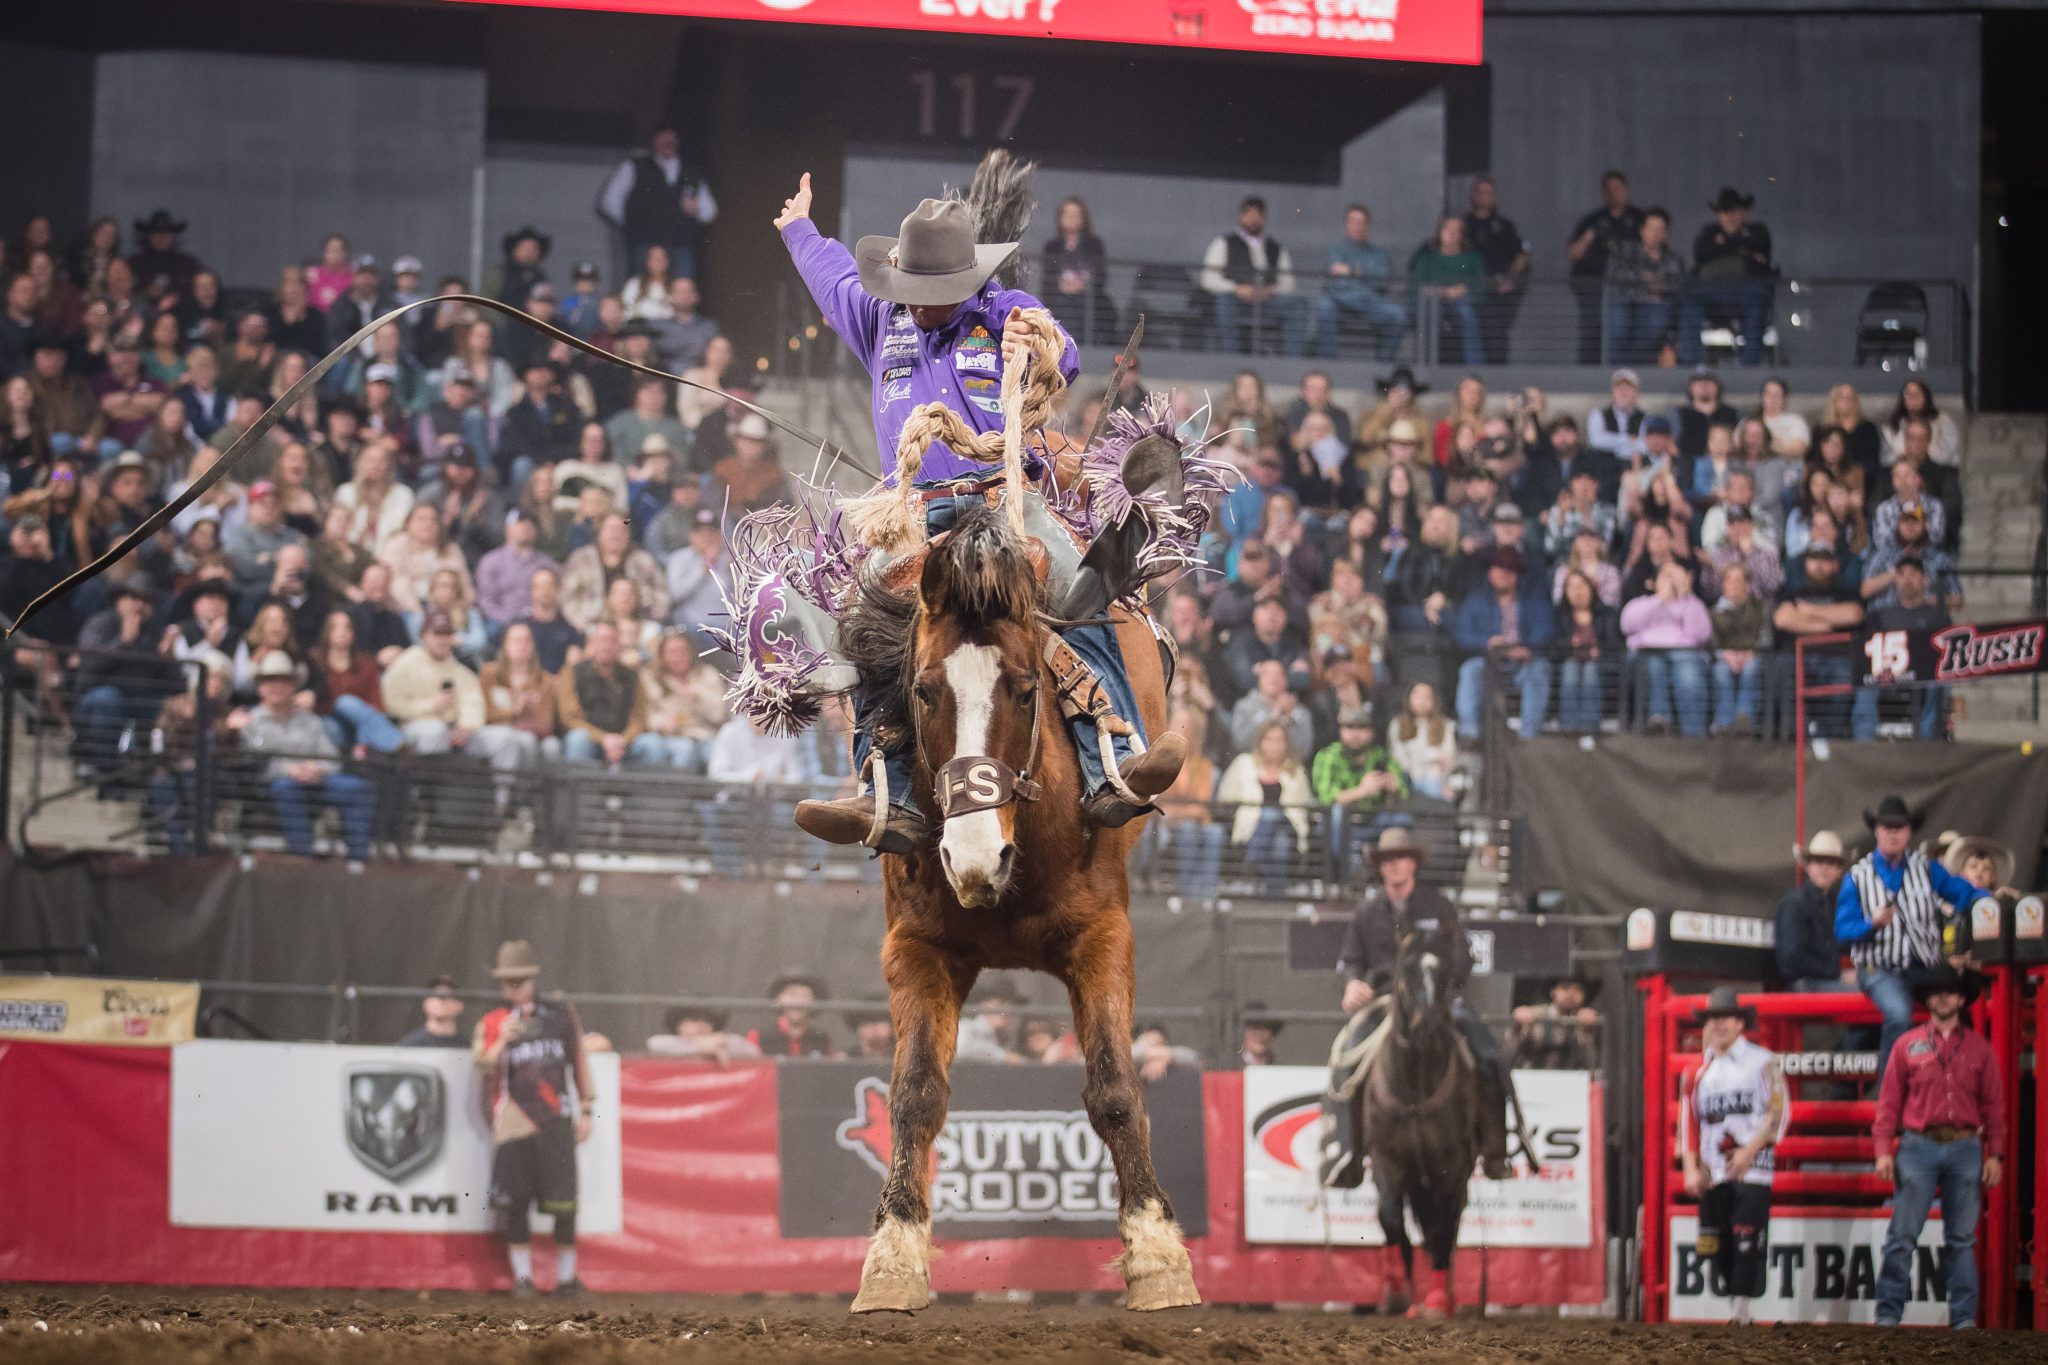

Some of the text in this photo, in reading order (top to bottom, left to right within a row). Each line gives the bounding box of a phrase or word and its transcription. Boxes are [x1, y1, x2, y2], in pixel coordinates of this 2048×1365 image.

[910, 71, 1034, 139] 117
[1865, 631, 1910, 676] 15
[935, 1121, 1114, 1170] SUTTO
[326, 1192, 458, 1214] RAM
[1813, 1245, 1948, 1302] BAN
